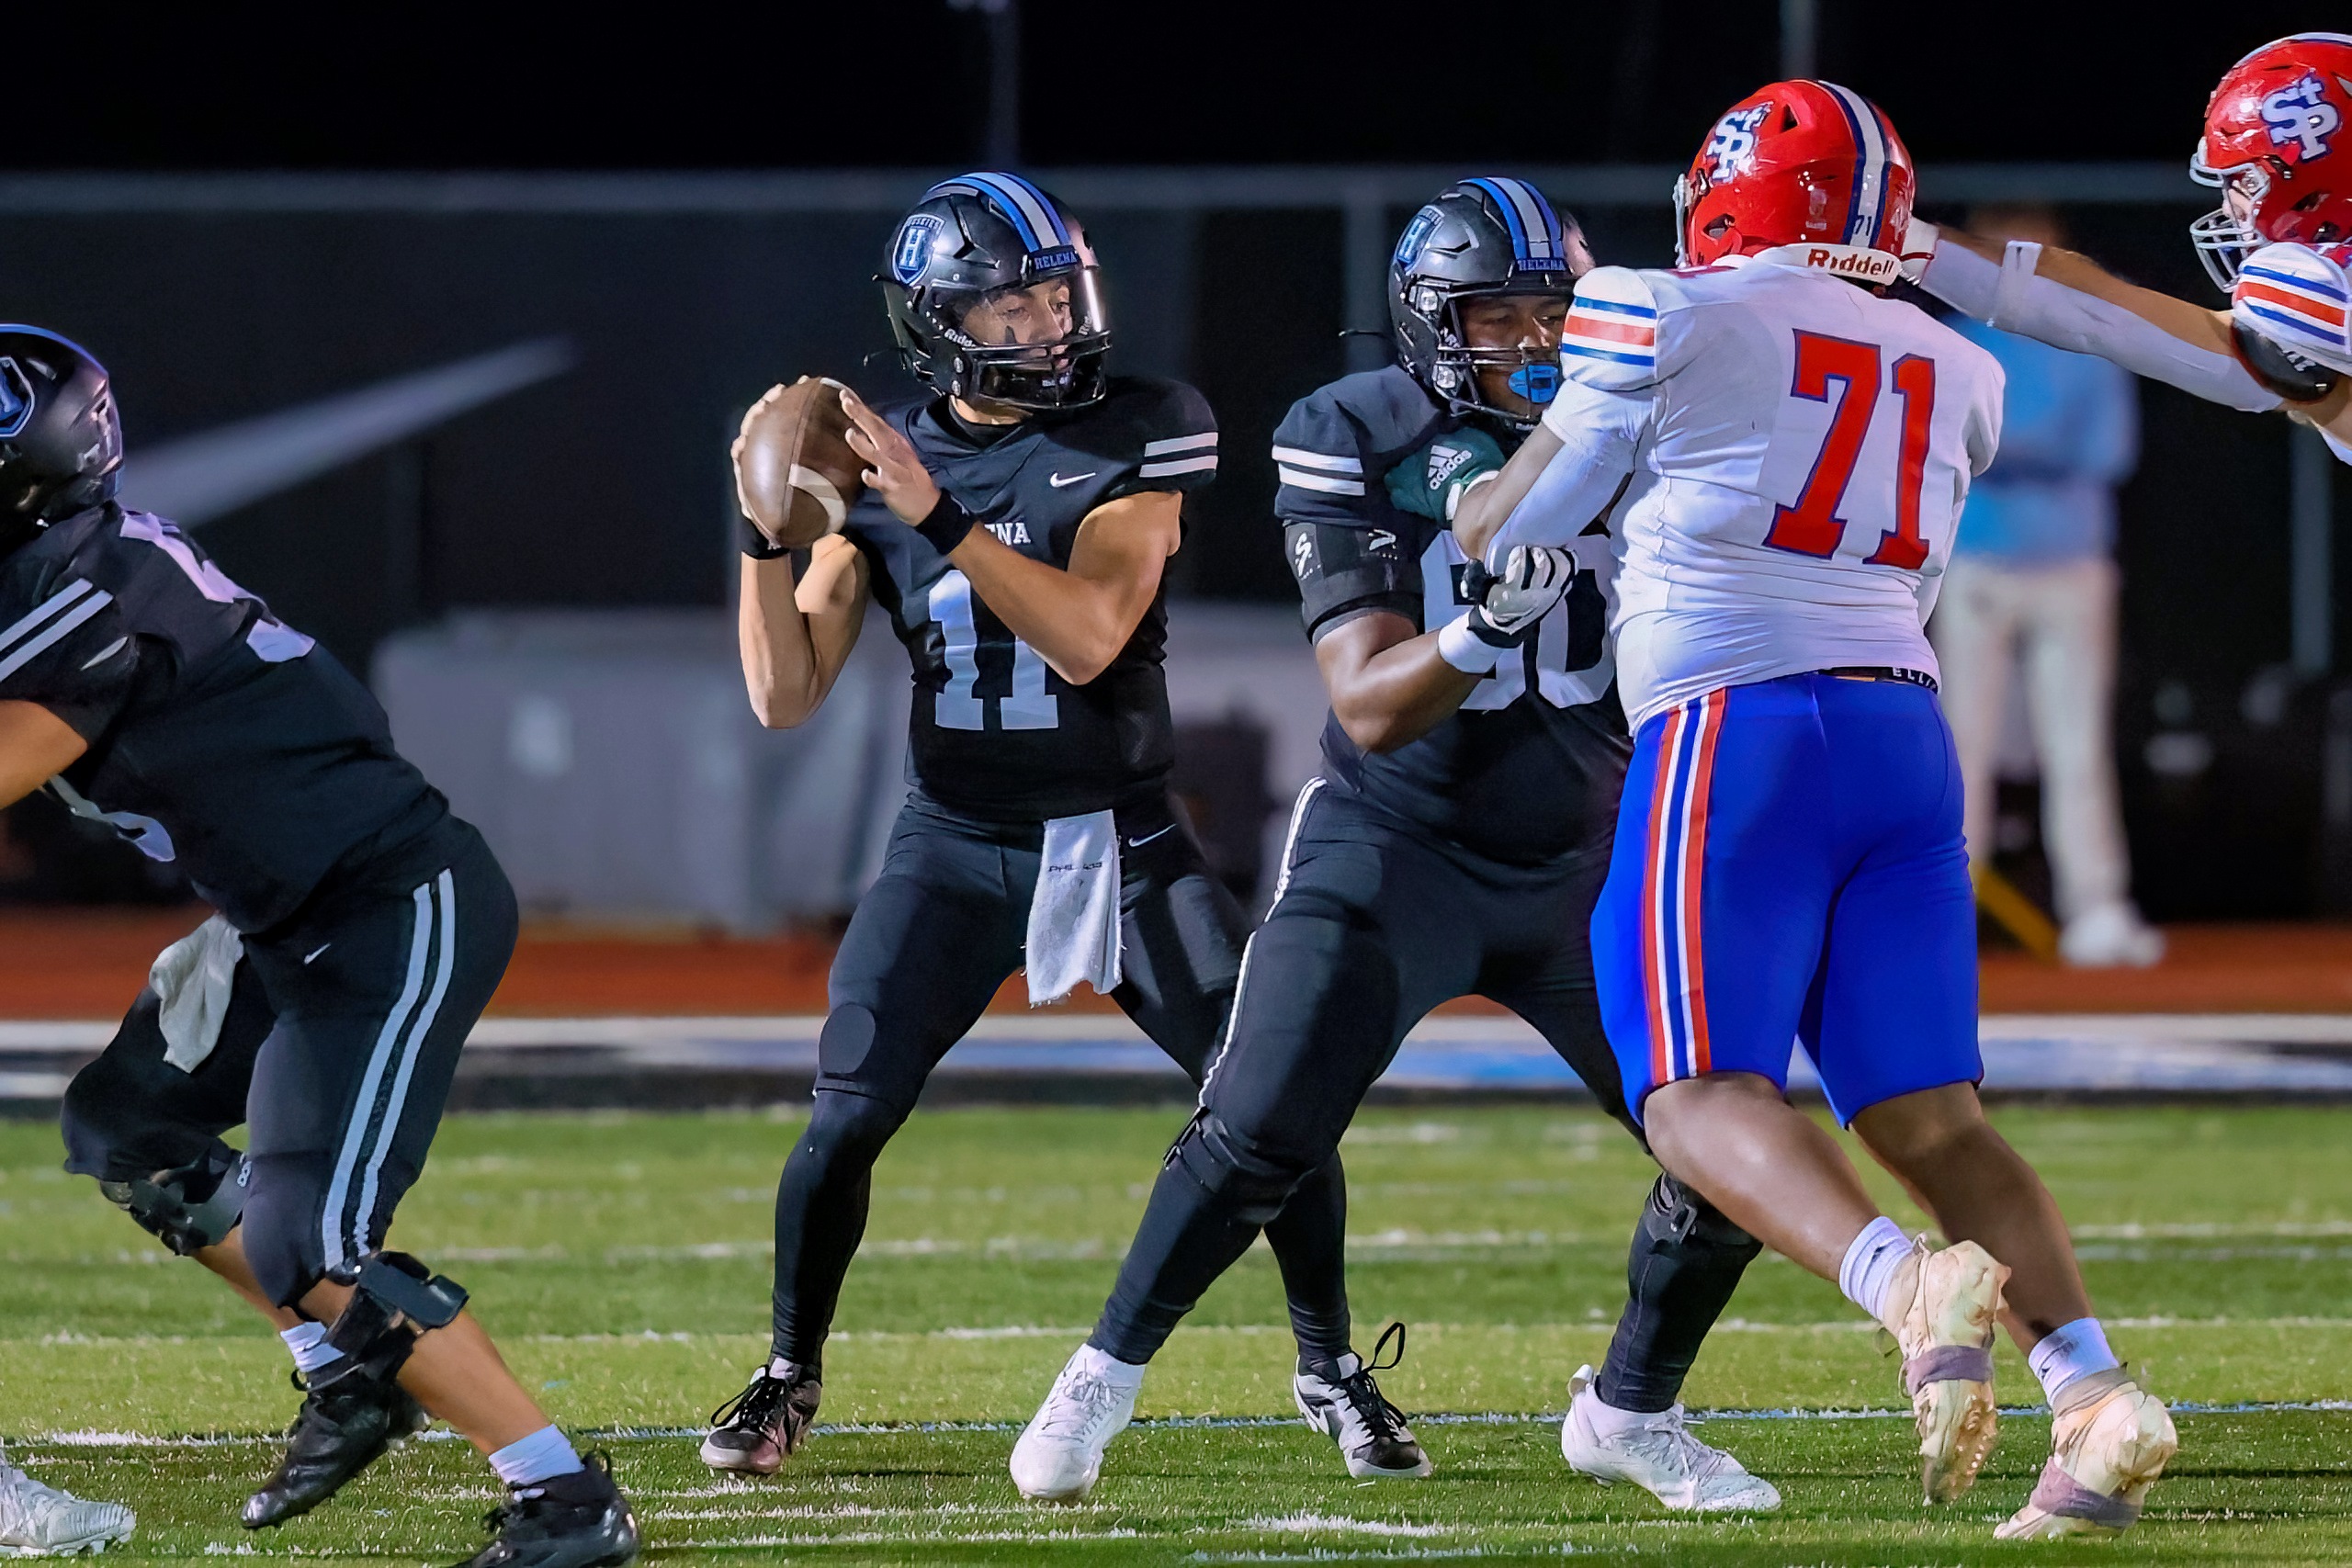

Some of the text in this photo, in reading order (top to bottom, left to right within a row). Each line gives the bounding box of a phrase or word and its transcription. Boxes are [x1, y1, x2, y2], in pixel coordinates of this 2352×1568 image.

[1855, 215, 1871, 236] 71
[899, 228, 926, 269] H
[1035, 252, 1079, 270] HELENA
[1808, 249, 1894, 276] Riddell
[1761, 328, 1936, 570] 71
[1430, 450, 1473, 491] adidas
[929, 570, 1059, 731] 11
